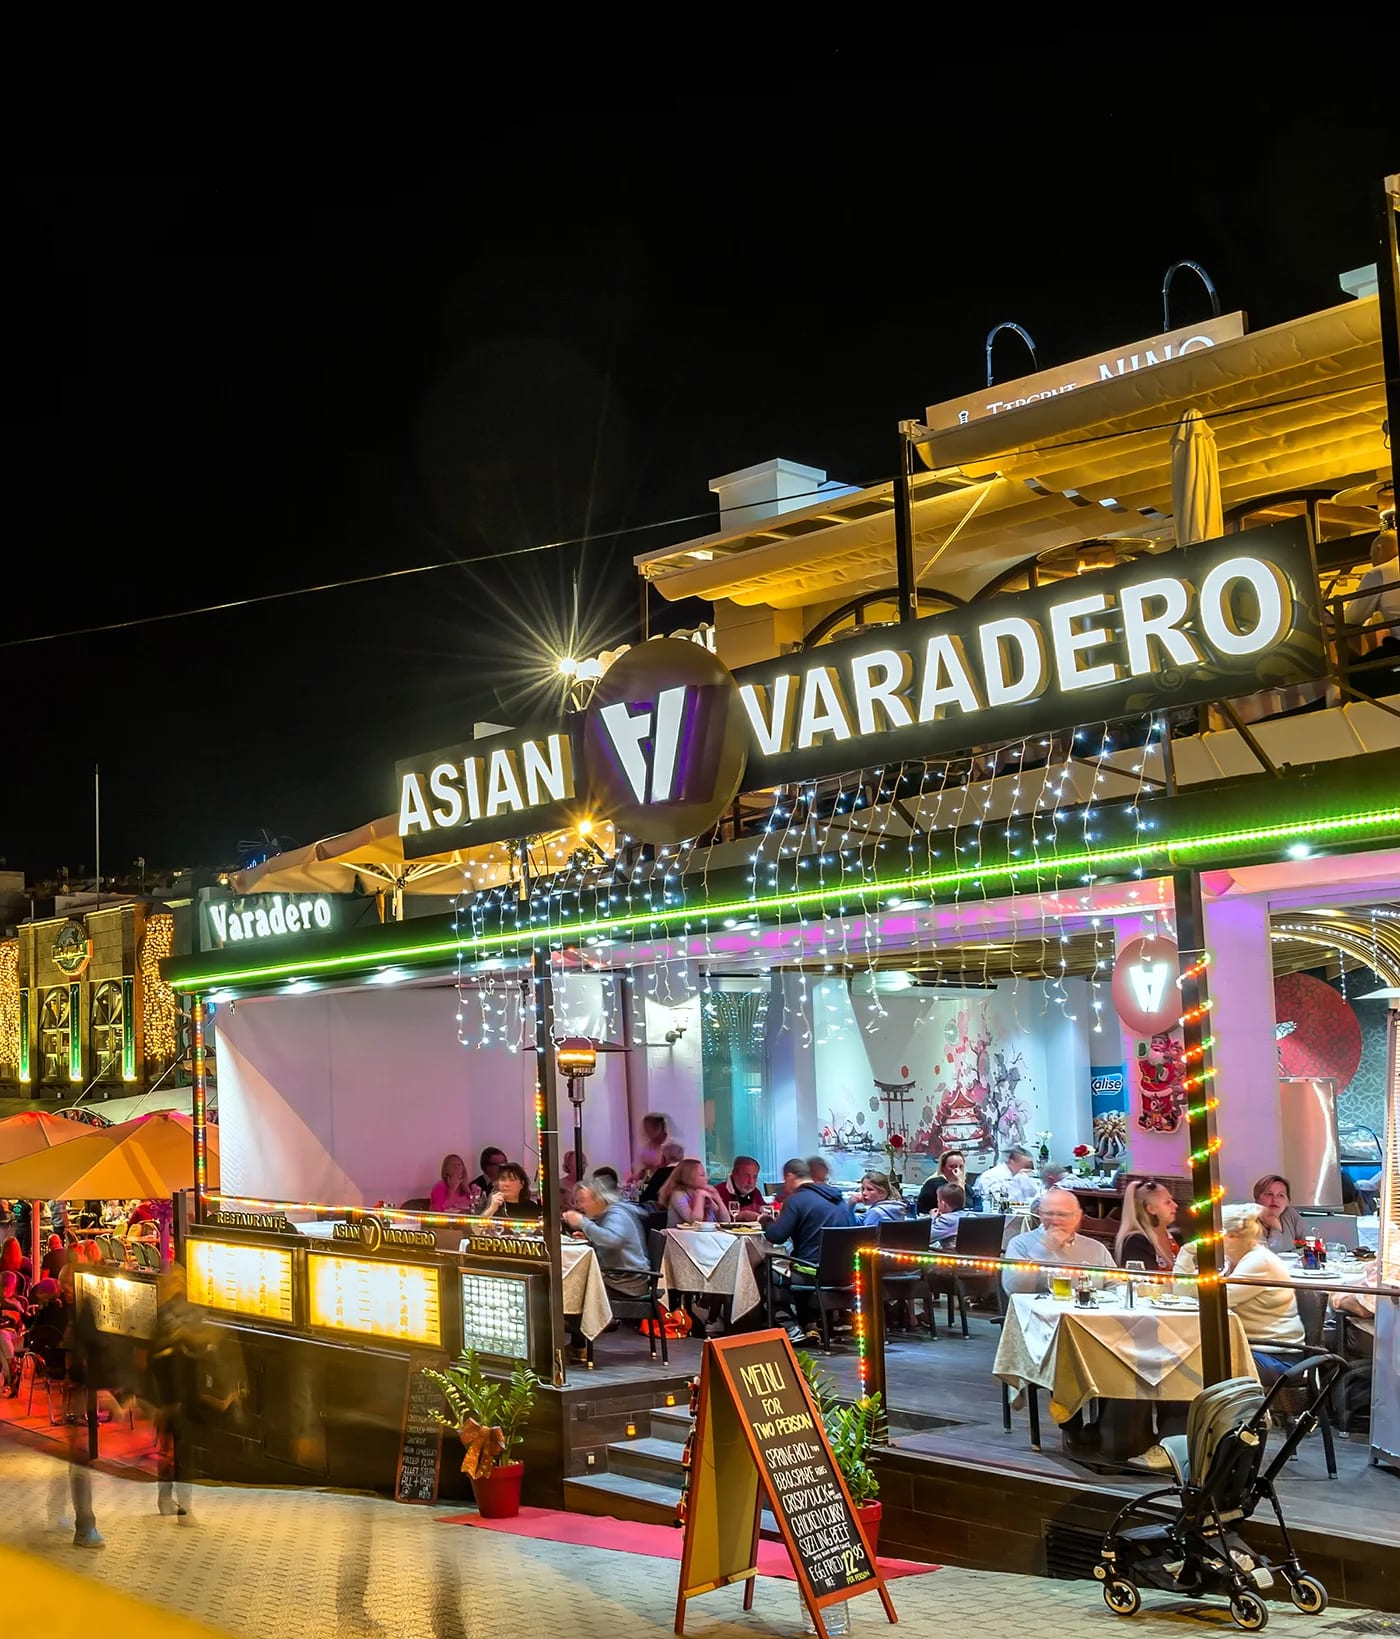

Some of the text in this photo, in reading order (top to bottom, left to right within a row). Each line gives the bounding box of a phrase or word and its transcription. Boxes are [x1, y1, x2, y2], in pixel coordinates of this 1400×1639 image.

[398, 733, 570, 837] ASIAN
[739, 557, 1288, 756] VARADERO
[209, 895, 332, 942] Varadero
[216, 1211, 286, 1230] RESTAURANTE
[333, 1223, 360, 1240] ASIAN
[383, 1229, 436, 1247] VARADERO
[740, 1361, 786, 1398] MENU
[761, 1397, 784, 1417] FOR
[752, 1412, 814, 1441] TWO PERSON
[765, 1445, 798, 1469] SPRING
[793, 1442, 815, 1463] ROLL
[782, 1490, 809, 1514] CRISPY
[807, 1484, 833, 1507] DUCK
[790, 1510, 825, 1538] CHICKEN
[829, 1522, 850, 1545] BEEF
[808, 1561, 827, 1583] EGG
[822, 1555, 844, 1577] FRIED
